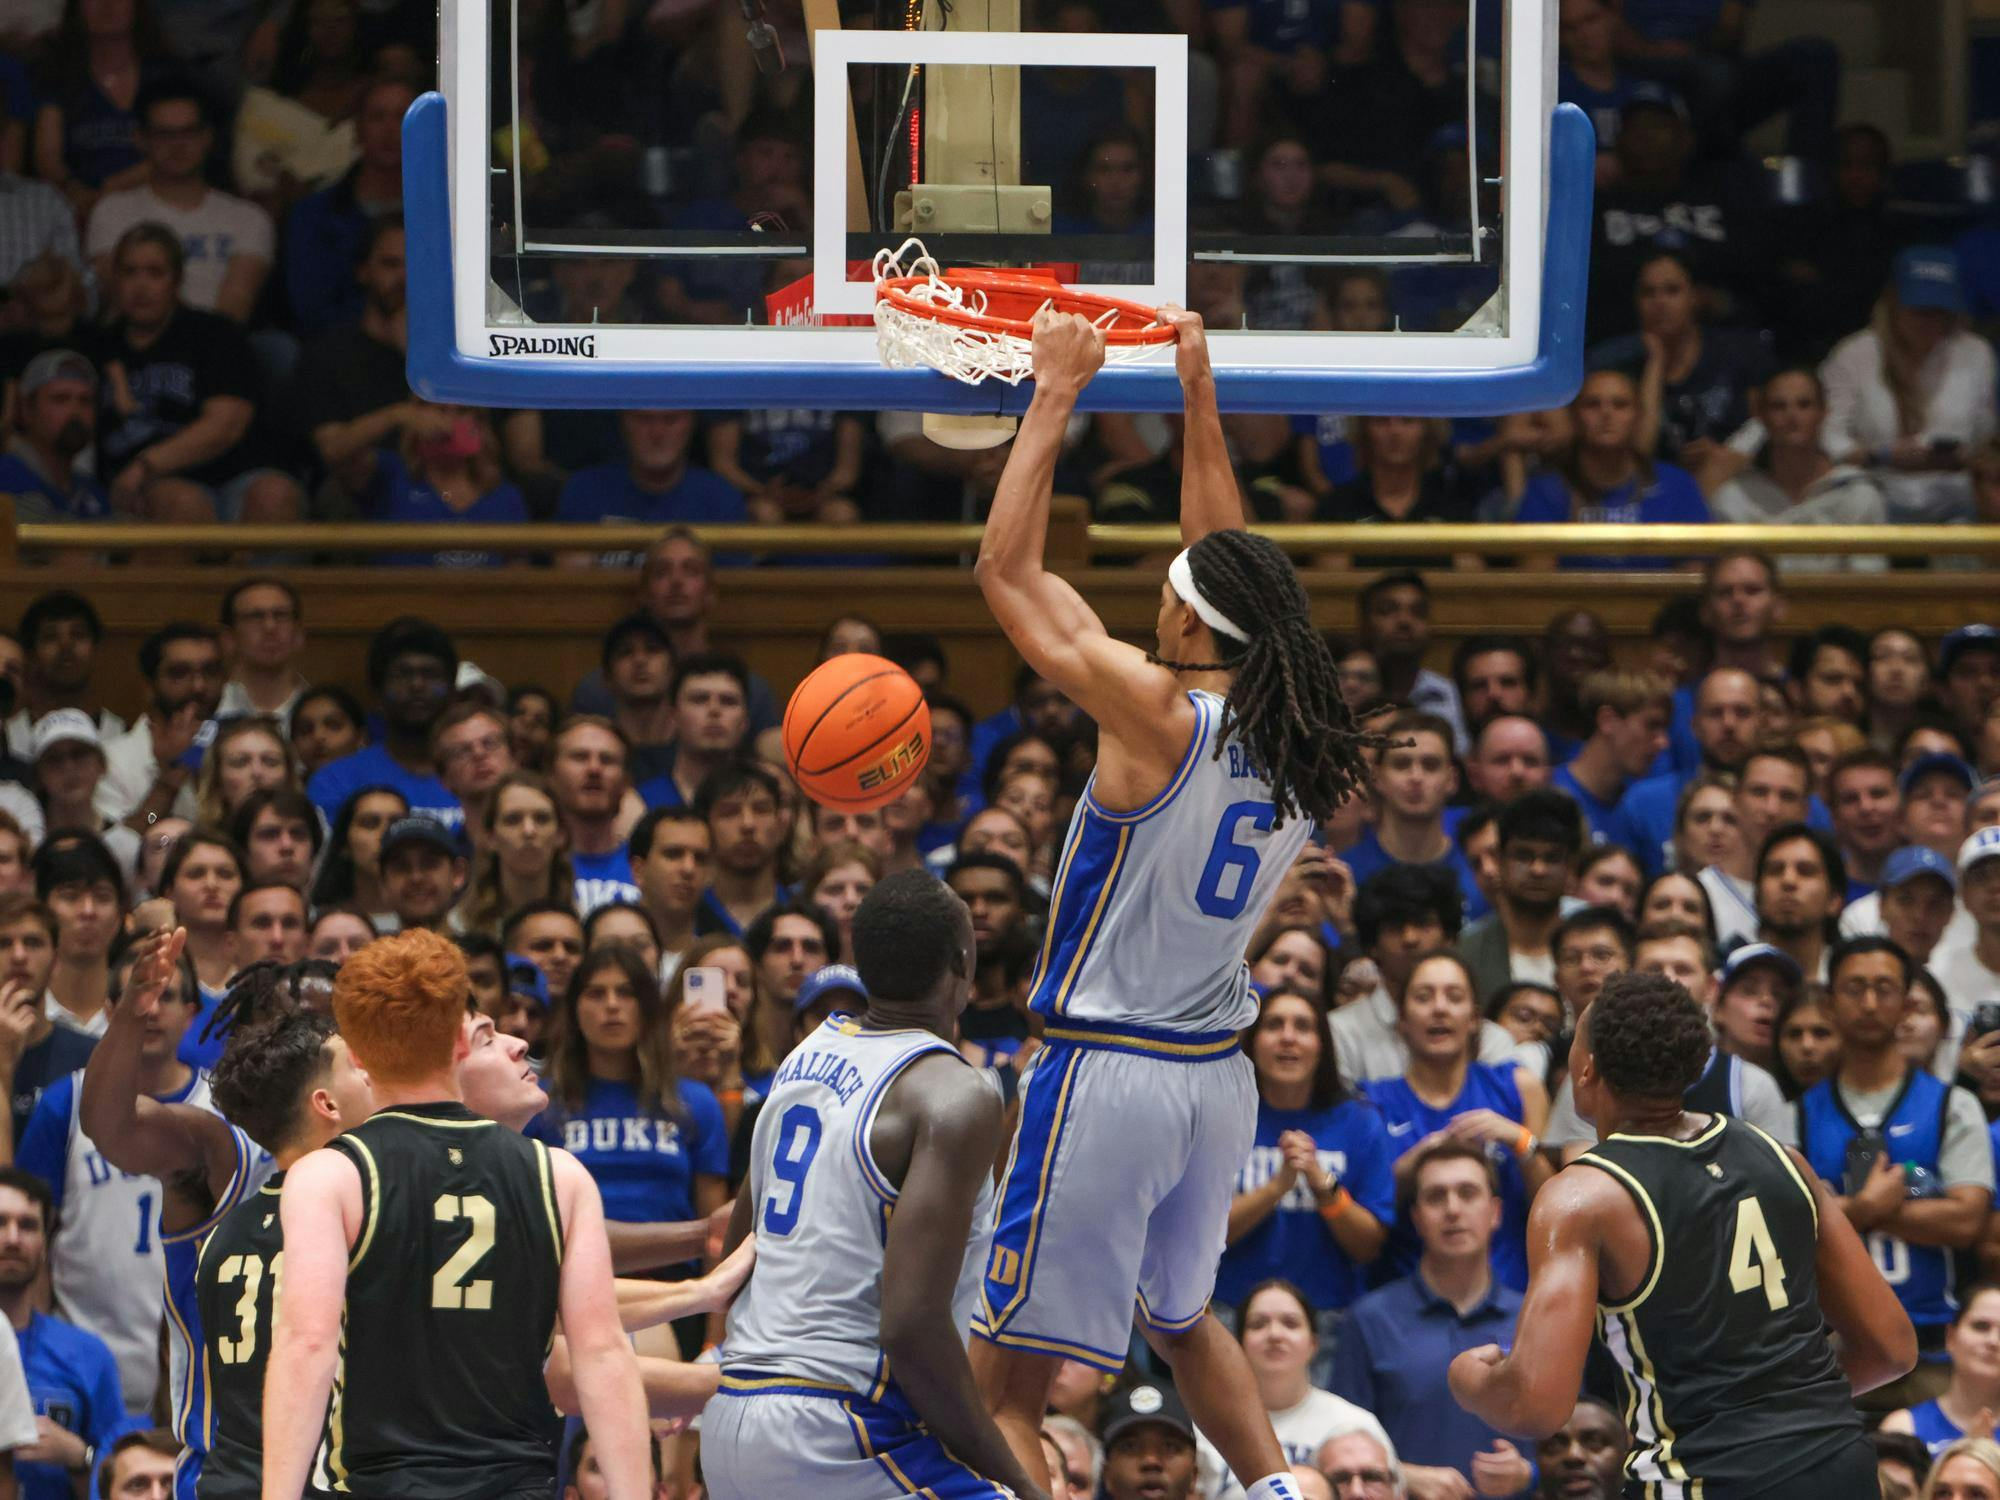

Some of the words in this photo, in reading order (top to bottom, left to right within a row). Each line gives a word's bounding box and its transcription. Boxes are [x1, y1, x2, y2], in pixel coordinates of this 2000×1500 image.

[489, 334, 595, 358] SPALDING
[858, 732, 924, 790] ELITE
[1194, 800, 1278, 920] 6
[777, 1052, 864, 1107] MALUACH
[563, 1117, 680, 1155] DUKE
[764, 1104, 822, 1236] 9
[135, 1192, 152, 1254] 1
[431, 1193, 496, 1310] 2
[1728, 1196, 1789, 1311] 4
